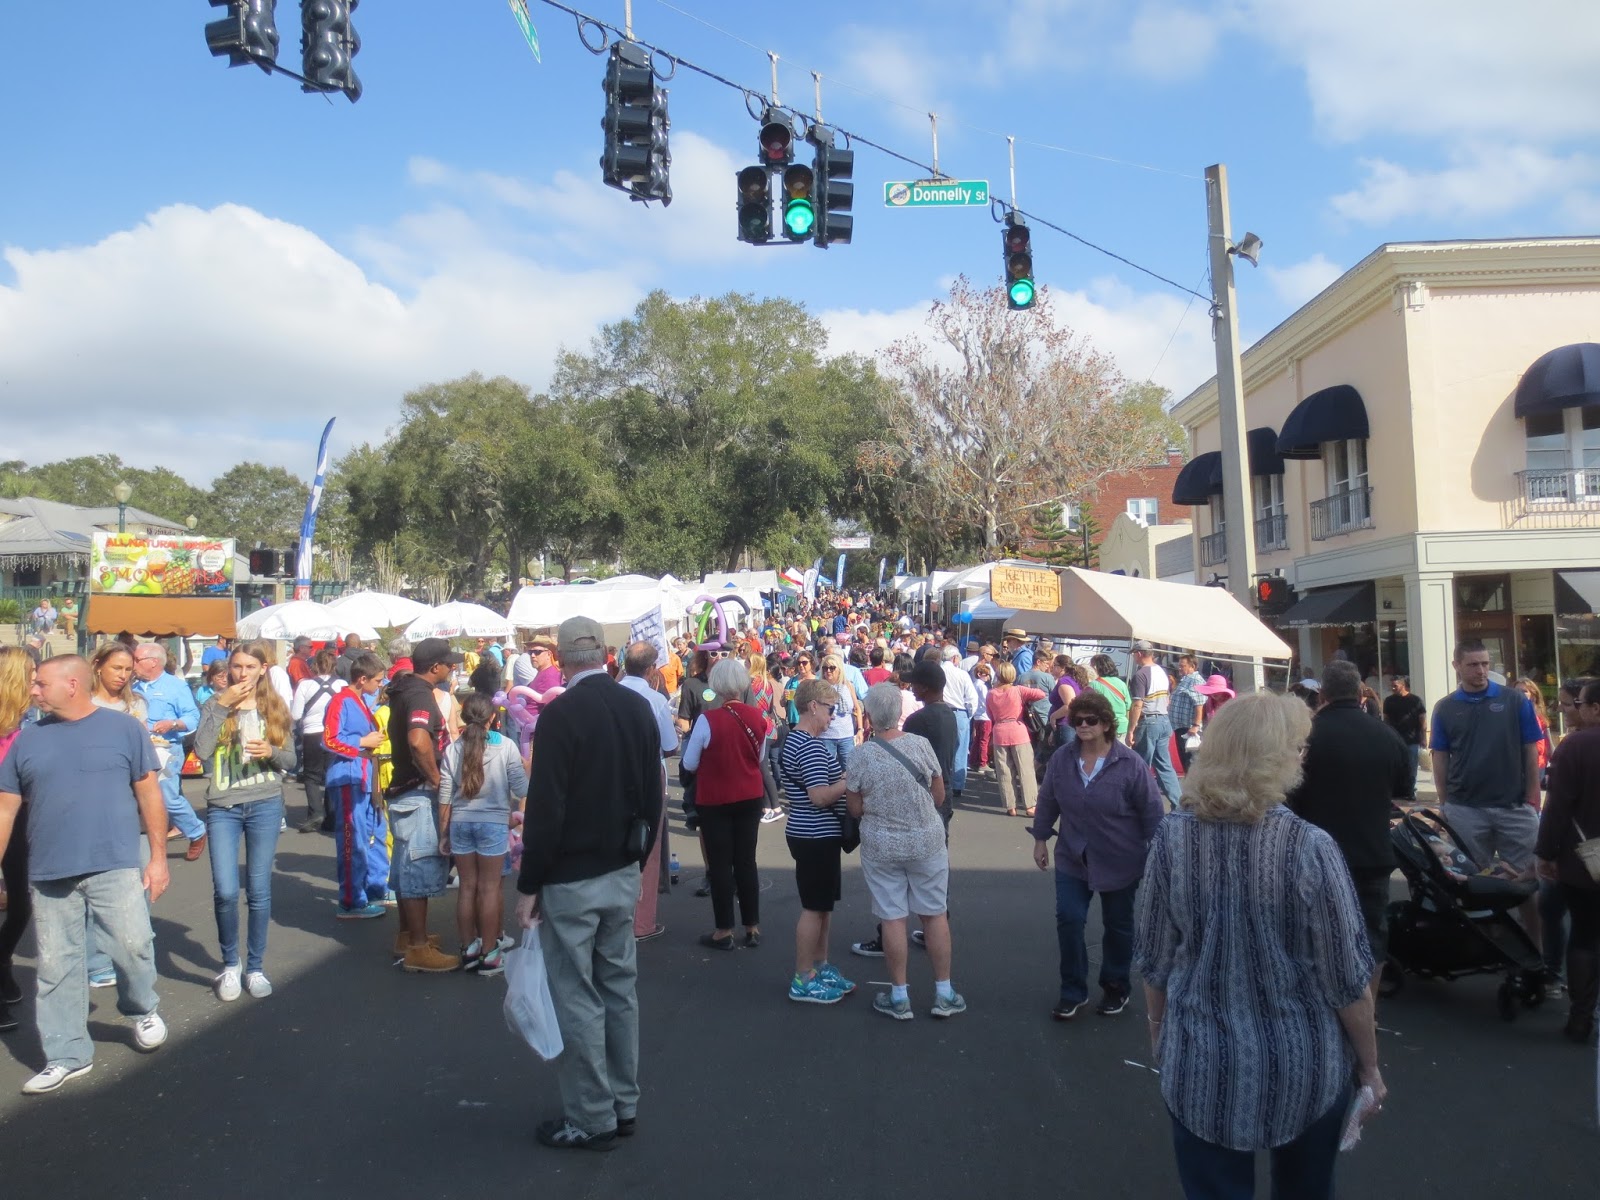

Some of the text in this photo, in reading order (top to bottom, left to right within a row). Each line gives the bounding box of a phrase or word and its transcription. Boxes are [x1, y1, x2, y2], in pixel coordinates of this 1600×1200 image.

[913, 187, 985, 204] Donnelly St
[105, 537, 223, 551] ALL NATURAL DRINKS
[1005, 569, 1046, 584] KETTLE
[1000, 581, 1052, 597] KORN HUT
[411, 627, 458, 639] ITALIAN SAUSAGE
[488, 626, 509, 634] SAUSAGE
